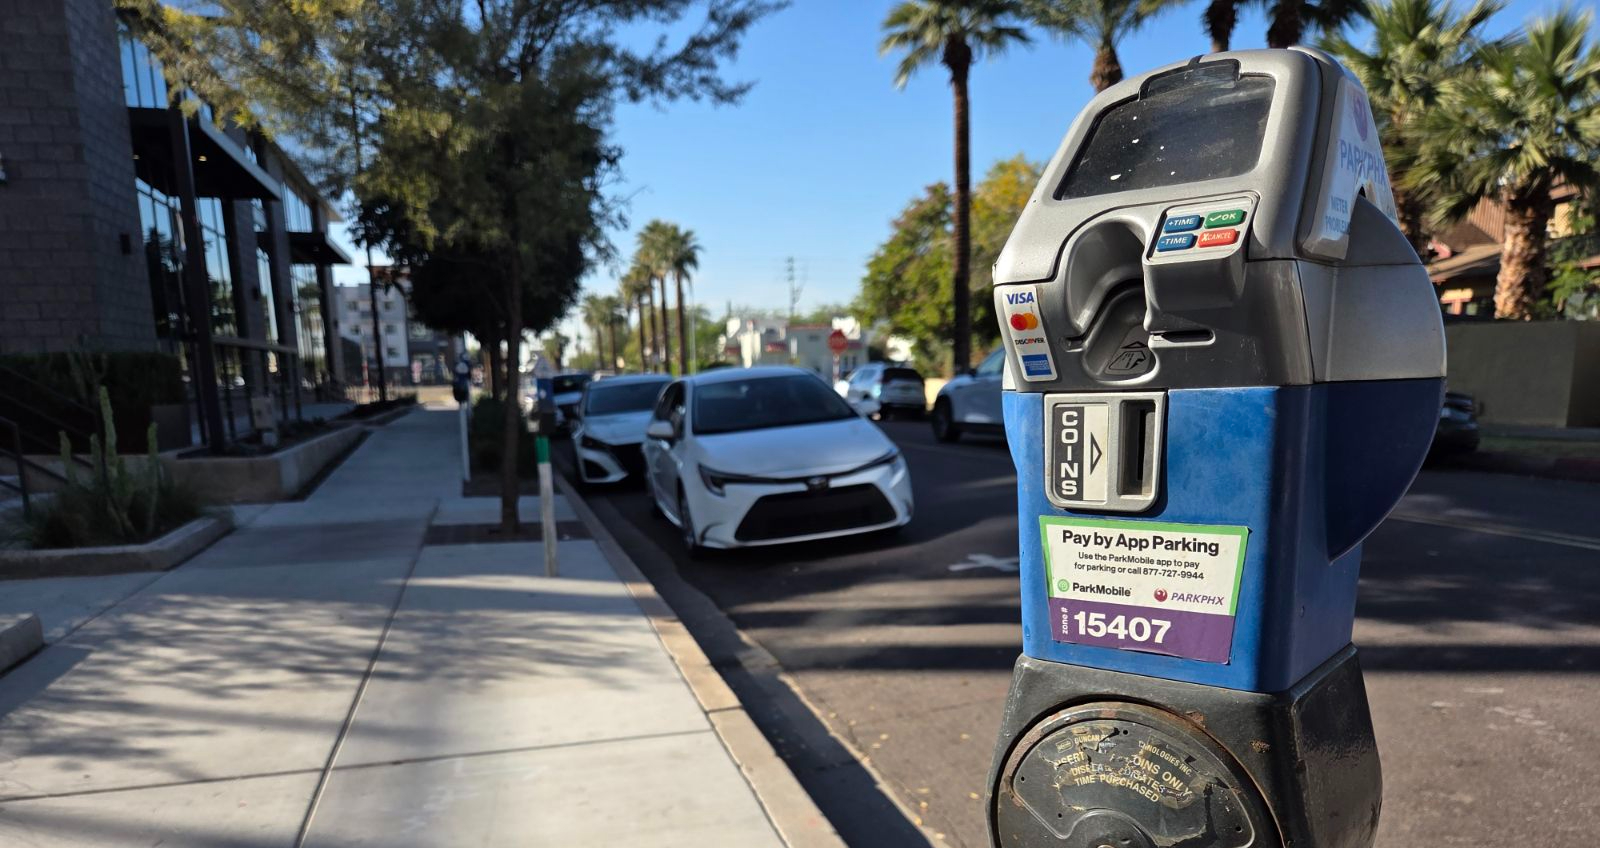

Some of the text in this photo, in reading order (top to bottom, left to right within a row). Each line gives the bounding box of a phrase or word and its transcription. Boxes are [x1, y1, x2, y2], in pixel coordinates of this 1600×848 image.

[1340, 139, 1386, 185] PARKPHX
[1330, 195, 1348, 214] METER
[1006, 292, 1035, 305] VISA
[1014, 337, 1045, 346] DISCOVER
[1060, 411, 1079, 495] COINS
[1062, 530, 1220, 557] Pay by App Parking
[1078, 551, 1200, 569] Use the ParkMobile app to pay
[1074, 562, 1205, 580] for parking or call 877-727-9944
[1072, 582, 1132, 597] ParkMobile
[1171, 592, 1225, 606] PARKPHX
[1061, 613, 1069, 634] zone
[1073, 610, 1172, 644] 15407
[1074, 734, 1100, 745] DUNCAN
[1053, 751, 1085, 770] NSERT
[1130, 754, 1161, 775] OINS
[1161, 771, 1193, 797] ONLY
[1074, 773, 1160, 803] TIME PURCHASED
